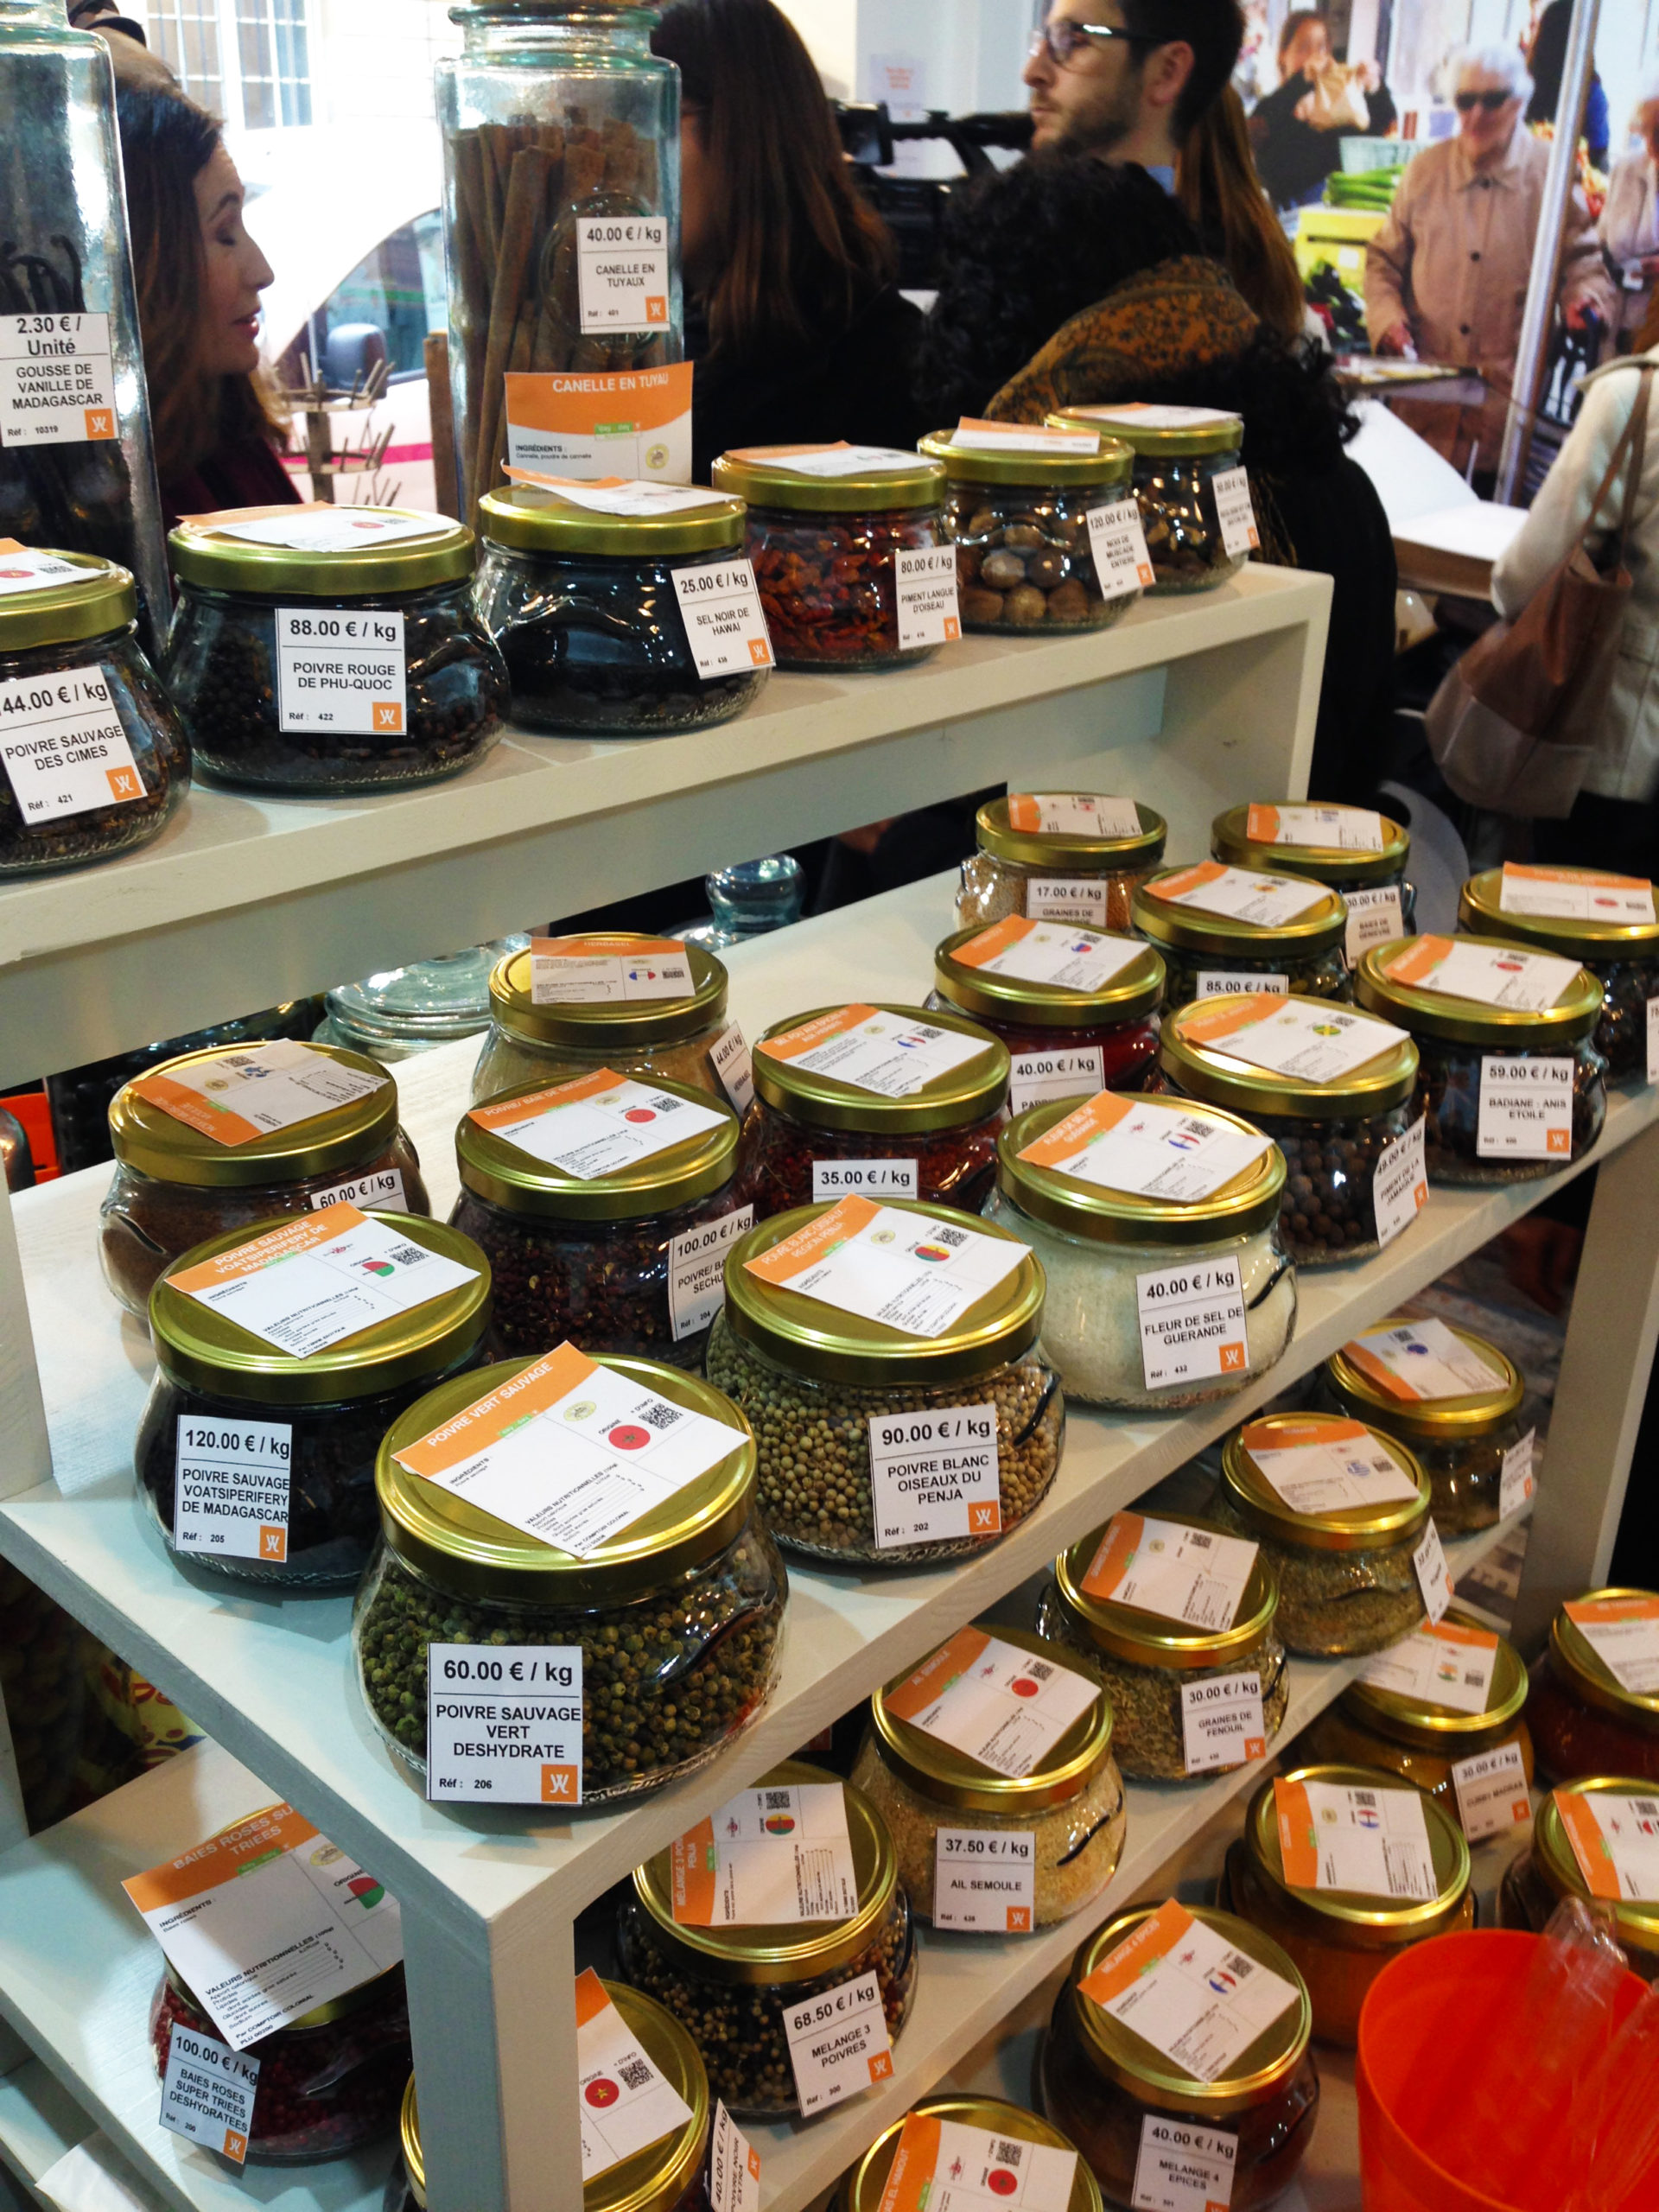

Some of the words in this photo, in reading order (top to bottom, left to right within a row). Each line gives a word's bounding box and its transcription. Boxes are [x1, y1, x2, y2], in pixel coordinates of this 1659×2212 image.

[587, 227, 622, 243] 40.00
[626, 226, 634, 240] €
[646, 226, 661, 243] kg
[596, 264, 639, 276] CANELLE
[642, 264, 655, 273] EN
[607, 276, 645, 288] TUYAUX
[16, 317, 54, 334] 2.30
[60, 316, 71, 332] €
[28, 338, 75, 356] Unité
[16, 365, 71, 378] GOUSSE
[75, 364, 92, 375] DE
[18, 379, 73, 393] VANILLE
[76, 379, 94, 390] DE
[553, 378, 615, 393] CANELLE
[619, 377, 636, 390] EN
[640, 373, 669, 388] TUYAU
[12, 393, 104, 410] MADAGASCAR
[35, 425, 59, 434] 10319
[1090, 512, 1115, 530] 120.00
[901, 558, 925, 573] 80.00
[929, 557, 933, 569] €
[942, 556, 951, 569] kg
[681, 575, 713, 594] 25.00
[716, 574, 723, 588] €
[733, 572, 748, 587] kg
[901, 591, 925, 603] PIMENT
[927, 587, 954, 600] LANGUE
[696, 614, 713, 626] SEL
[715, 610, 735, 622] NOIR
[738, 607, 749, 618] DE
[913, 601, 944, 613] D'OISEAU
[290, 620, 340, 636] 88.00
[346, 621, 357, 637] €
[374, 623, 396, 641] kg
[712, 623, 741, 635] HAWAI
[293, 663, 344, 674] POIVRE
[347, 664, 396, 676] ROUGE
[298, 677, 316, 688] DE
[321, 678, 392, 690] PHU-QUOC
[0, 690, 54, 716] 44.00
[57, 686, 71, 703] €
[83, 683, 107, 701] kg
[5, 739, 59, 759] POIVRE
[60, 725, 123, 747] SAUVAGE
[35, 755, 63, 771] DES
[67, 746, 108, 763] CIMES
[57, 794, 73, 804] 421
[1038, 887, 1066, 897] 17.00
[1088, 888, 1101, 899] kg
[1206, 981, 1241, 994] 85.00
[1017, 1061, 1052, 1076] 40.00
[1058, 1059, 1065, 1071] €
[1078, 1058, 1095, 1071] kg
[1490, 1065, 1526, 1079] 59.00
[1552, 1067, 1568, 1084] kg
[1489, 1098, 1533, 1109] BADIANE
[1543, 1098, 1567, 1108] ANIS
[821, 1172, 862, 1185] 35.00
[868, 1171, 876, 1184] €
[892, 1170, 910, 1186] kg
[321, 1186, 355, 1209] 6000
[359, 1182, 367, 1195] €
[378, 1176, 395, 1189] kg
[215, 1244, 259, 1266] POIVRE
[258, 1221, 312, 1246] SAUVAGE
[677, 1230, 716, 1256] 100.00
[720, 1225, 728, 1238] €
[737, 1217, 750, 1231] kg
[216, 1231, 309, 1274] VOATSIPERIFERY
[309, 1224, 327, 1235] DE
[1147, 1278, 1187, 1299] 40.00
[1192, 1275, 1201, 1289] €
[1216, 1271, 1234, 1287] kg
[1145, 1319, 1182, 1336] FLEUR
[1185, 1315, 1200, 1326] DE
[1204, 1311, 1224, 1324] SEL
[1228, 1306, 1243, 1319] DE
[1163, 1324, 1227, 1344] GUERANDE
[427, 1415, 473, 1446] POIVRE
[469, 1396, 501, 1418] VERT
[499, 1362, 553, 1399] SAUVAGE
[882, 1424, 932, 1445] 90.00
[938, 1422, 950, 1438] €
[968, 1420, 990, 1437] kg
[186, 1430, 240, 1450] 120.00
[245, 1435, 255, 1452] €
[270, 1438, 289, 1459] kg
[888, 1460, 938, 1478] POIVRE
[943, 1454, 989, 1470] BLANC
[182, 1469, 229, 1483] POIVRE
[232, 1473, 289, 1491] SAUVAGE
[898, 1474, 957, 1492] OISEAUX
[963, 1471, 982, 1484] DU
[184, 1484, 288, 1506] VOATSIPERIFERY
[918, 1489, 963, 1504] PENJA
[182, 1501, 200, 1513] DE
[204, 1503, 289, 1522] MADAGASCAR
[913, 1522, 929, 1531] 202
[210, 1535, 225, 1543] 205
[444, 1660, 502, 1681] 60.00
[510, 1662, 524, 1681] €
[545, 1662, 572, 1687] kg
[1190, 1686, 1220, 1704] 30.00
[1224, 1684, 1230, 1694] €
[1243, 1681, 1258, 1694] kg
[436, 1705, 497, 1719] POIVRE
[501, 1707, 581, 1721] SAUVAGE
[1199, 1713, 1237, 1728] GRAINES
[486, 1725, 531, 1738] VERT
[1207, 1724, 1244, 1737] FENOUIL
[454, 1743, 564, 1758] DESHYDRATE
[474, 1780, 493, 1789] 206
[172, 1844, 218, 1871] BAIES
[219, 1819, 271, 1847] ROSES
[273, 1806, 295, 1821] SU
[229, 1826, 283, 1856] TRIEES
[945, 1839, 984, 1853] 37.50
[988, 1841, 997, 1853] €
[1011, 1841, 1028, 1857] kg
[950, 1879, 967, 1889] AIL
[970, 1880, 1021, 1891] SEMOULE
[206, 1974, 243, 1995] VALEURS
[243, 1936, 315, 1977] NUTRITIONNELLES
[248, 2012, 282, 2031] COMPTOIR
[283, 1994, 314, 2013] COLONIAL
[794, 2003, 833, 2030] 68.50
[836, 1997, 845, 2011] €
[857, 1986, 874, 2002] kg
[811, 2025, 862, 2058] MELANGE
[865, 2024, 871, 2033] 3
[176, 2036, 219, 2064] 100.00
[222, 2056, 231, 2070] €
[242, 2063, 257, 2086] kg
[822, 2040, 867, 2067] POIVRES
[181, 2069, 210, 2088] BAIES
[212, 2084, 245, 2105] ROSES
[176, 2080, 209, 2101] SUPER
[212, 2095, 246, 2118] TRIEES
[169, 2091, 248, 2133] DESHYDRATEES
[1153, 2126, 1191, 2145] 40.00
[1217, 2141, 1234, 2158] kg
[1160, 2160, 1210, 2177] MELANGE
[1168, 2174, 1206, 2190] EPICES
